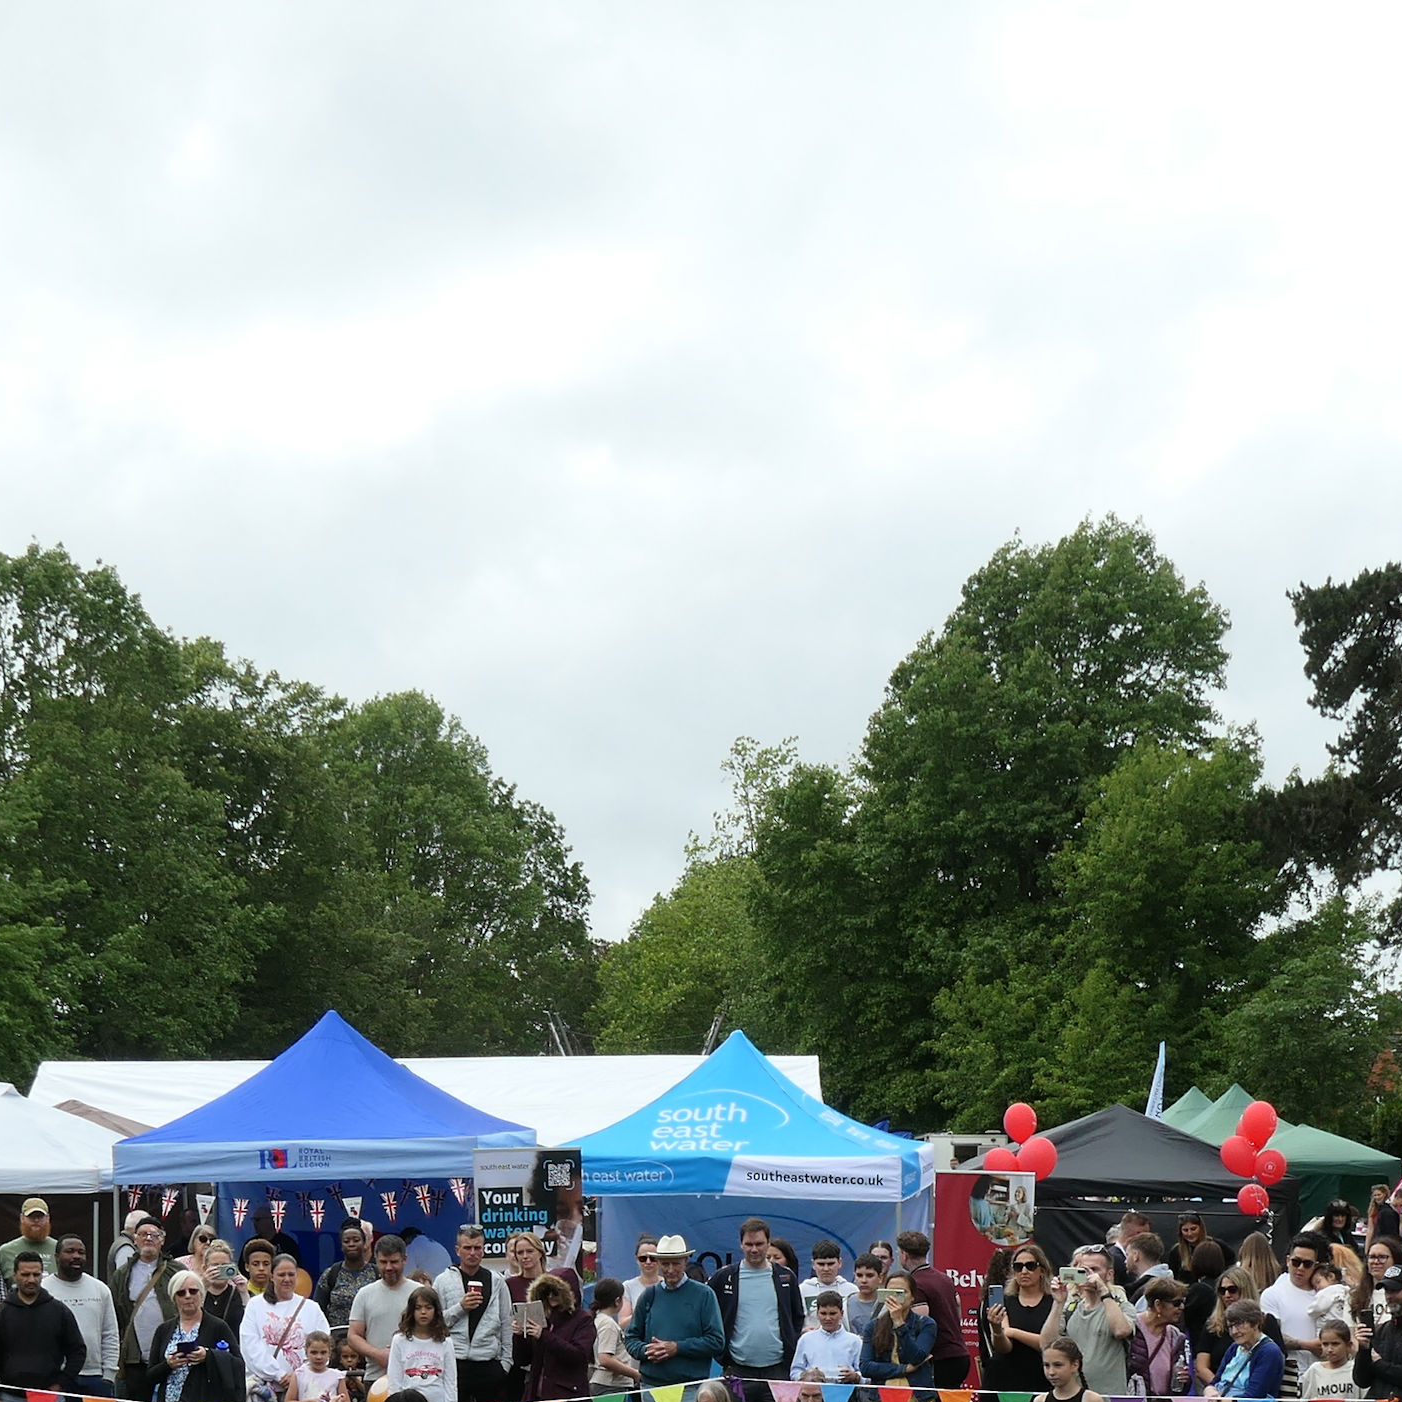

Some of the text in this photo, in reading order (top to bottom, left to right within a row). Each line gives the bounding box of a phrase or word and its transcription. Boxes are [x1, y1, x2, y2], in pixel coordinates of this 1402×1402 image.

[657, 1102, 748, 1124] south
[652, 1122, 722, 1139] east
[649, 1137, 750, 1152] water
[591, 1172, 621, 1182] east
[623, 1169, 666, 1182] water
[745, 1169, 884, 1187] southeastwater.co.uk
[482, 1191, 519, 1205] Your
[482, 1207, 548, 1224] drinking
[406, 1351, 441, 1360] California
